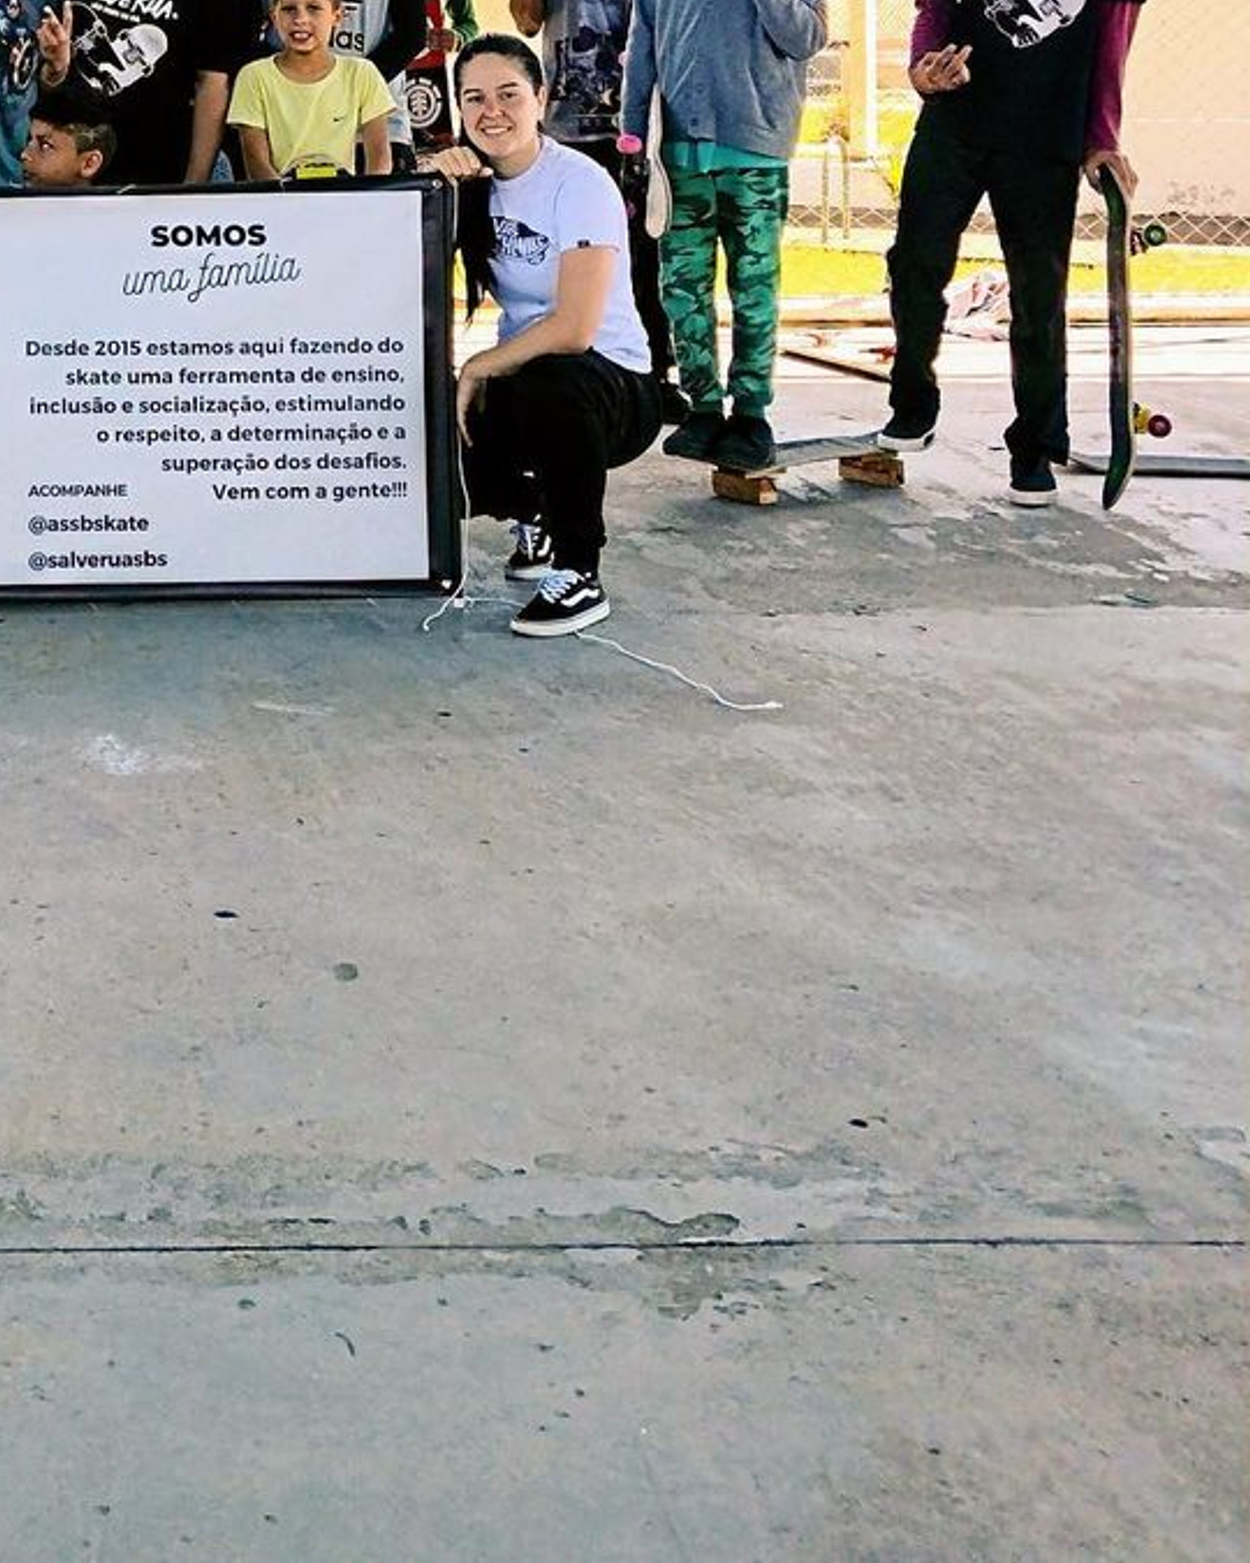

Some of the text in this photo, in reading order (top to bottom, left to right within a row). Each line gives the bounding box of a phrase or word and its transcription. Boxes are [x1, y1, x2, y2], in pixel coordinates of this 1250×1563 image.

[151, 224, 267, 247] SOMOS
[122, 252, 301, 303] uma família
[26, 337, 403, 360] Desde 2015 estamos aqui fazendo do
[66, 365, 404, 386] skate uma ferramenta de ensino,
[30, 394, 405, 417] inclusão e socialização, estimulando
[97, 423, 406, 447] o respeito, a determinação e a
[162, 452, 406, 475] superação dos desafios.
[28, 484, 127, 498] ACOMPANHE
[213, 482, 407, 503] Vem com a gente!!!
[28, 515, 149, 534] @assbskate
[28, 550, 168, 571] @salveruasbs
